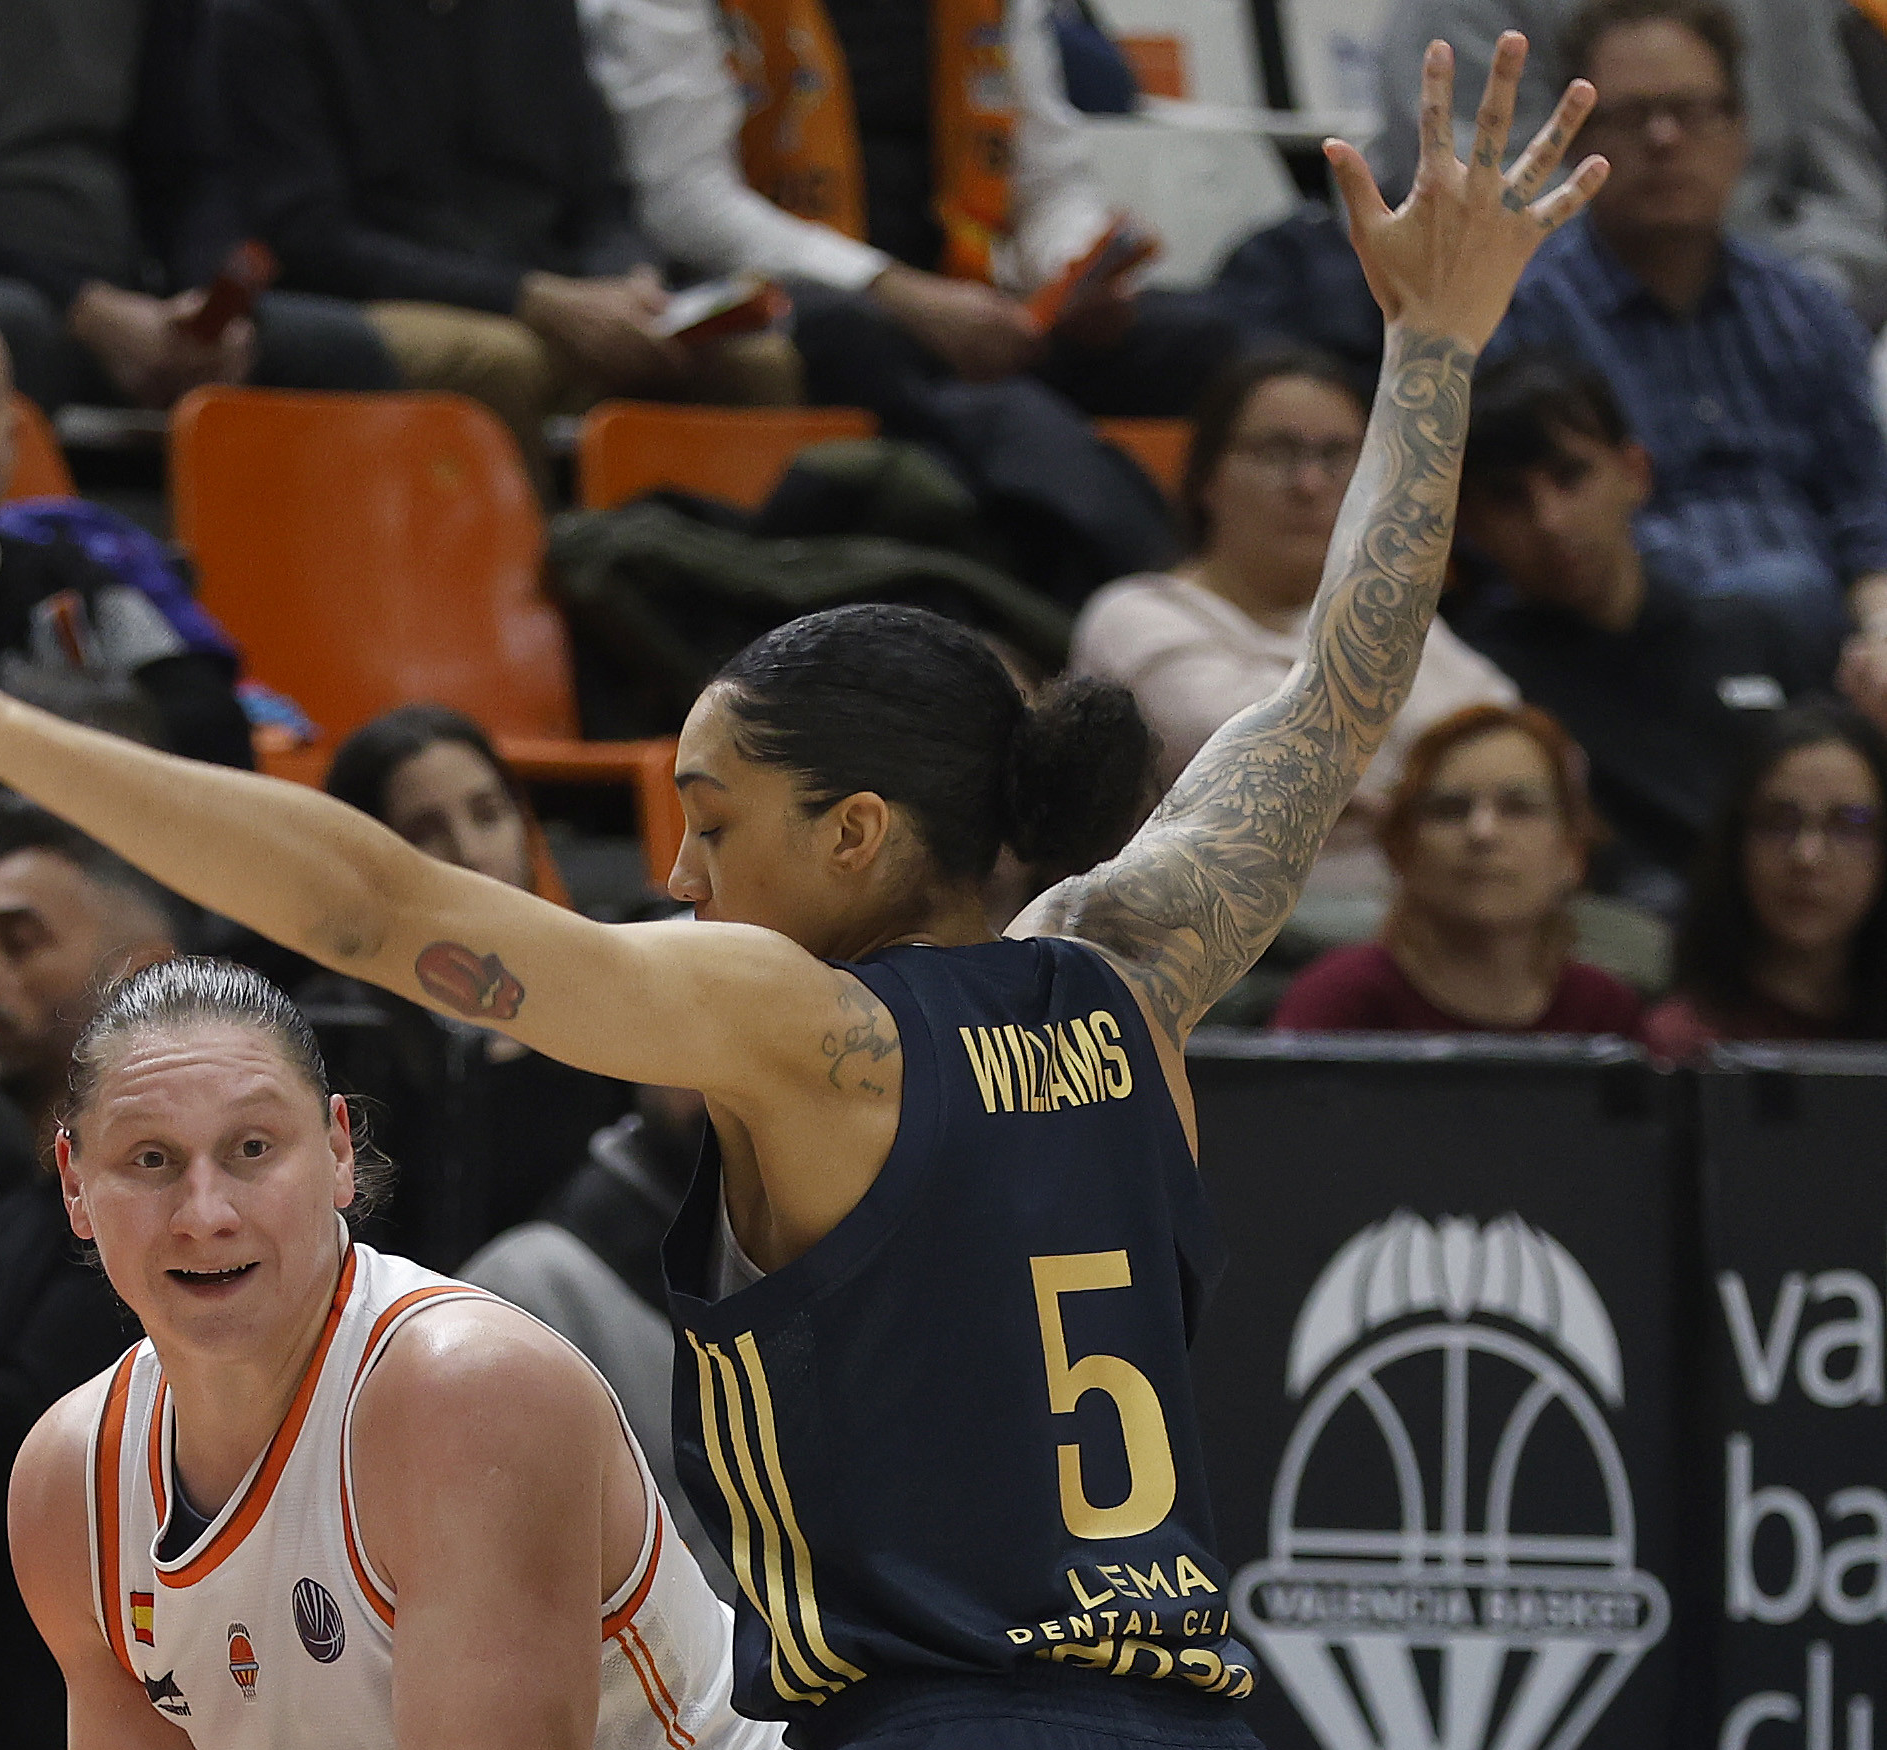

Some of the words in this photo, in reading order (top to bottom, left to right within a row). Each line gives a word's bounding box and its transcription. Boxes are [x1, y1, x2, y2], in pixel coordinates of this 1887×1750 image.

[1029, 1249, 1177, 1540] 5
[1066, 1555, 1219, 1610] LEMA
[1006, 1610, 1163, 1645] DENTAL
